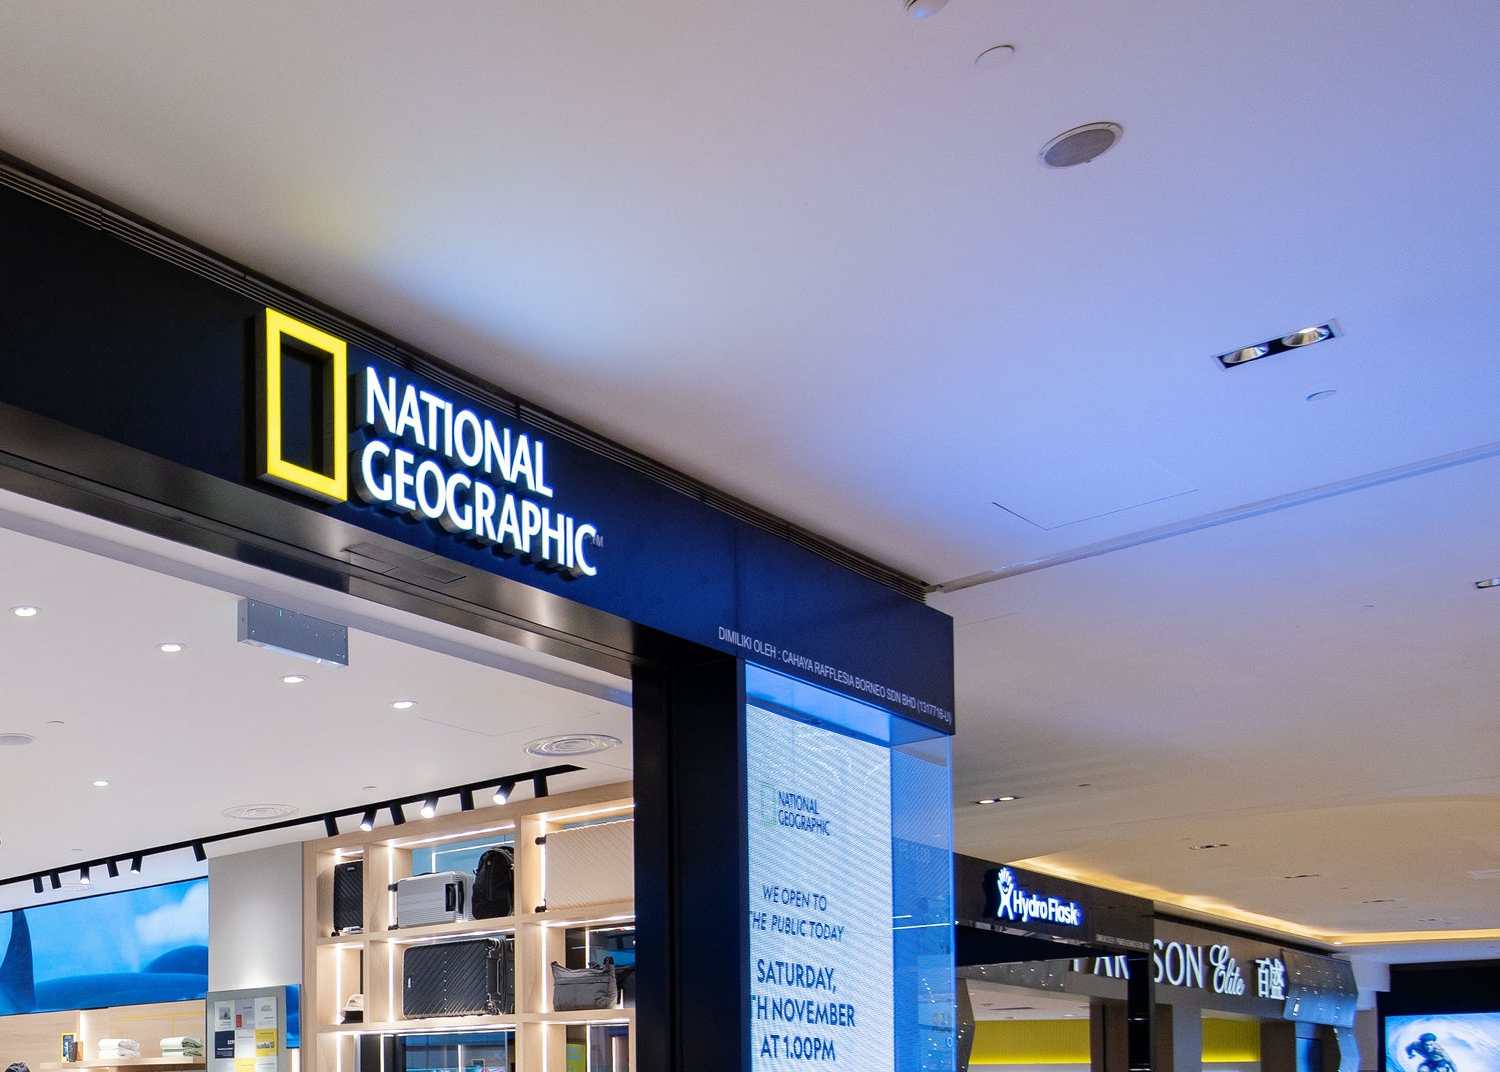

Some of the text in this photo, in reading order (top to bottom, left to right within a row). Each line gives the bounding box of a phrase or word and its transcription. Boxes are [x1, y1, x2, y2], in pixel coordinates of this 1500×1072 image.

[366, 366, 553, 498] NATIONAL
[361, 440, 598, 577] GEOGRAPHIC
[718, 626, 752, 650] DIMILIKI
[753, 640, 777, 659] OLEH
[782, 650, 814, 672] CAHAYA
[814, 661, 855, 687] RAFFLESIA
[855, 677, 886, 698] BORNEO
[886, 688, 901, 704] SDN
[902, 694, 916, 709] BHD
[778, 790, 820, 815] NATIONAL
[778, 810, 830, 836] GEOGRAPHIC
[762, 884, 828, 911] WE OPEN TO
[771, 914, 807, 937] PUBLIC
[809, 920, 845, 942] TODAY
[756, 958, 837, 994] SATURDAY,
[1209, 944, 1245, 996] Elite
[772, 998, 856, 1027] NOVEMBER
[760, 1035, 836, 1061] AT 1.00PM
